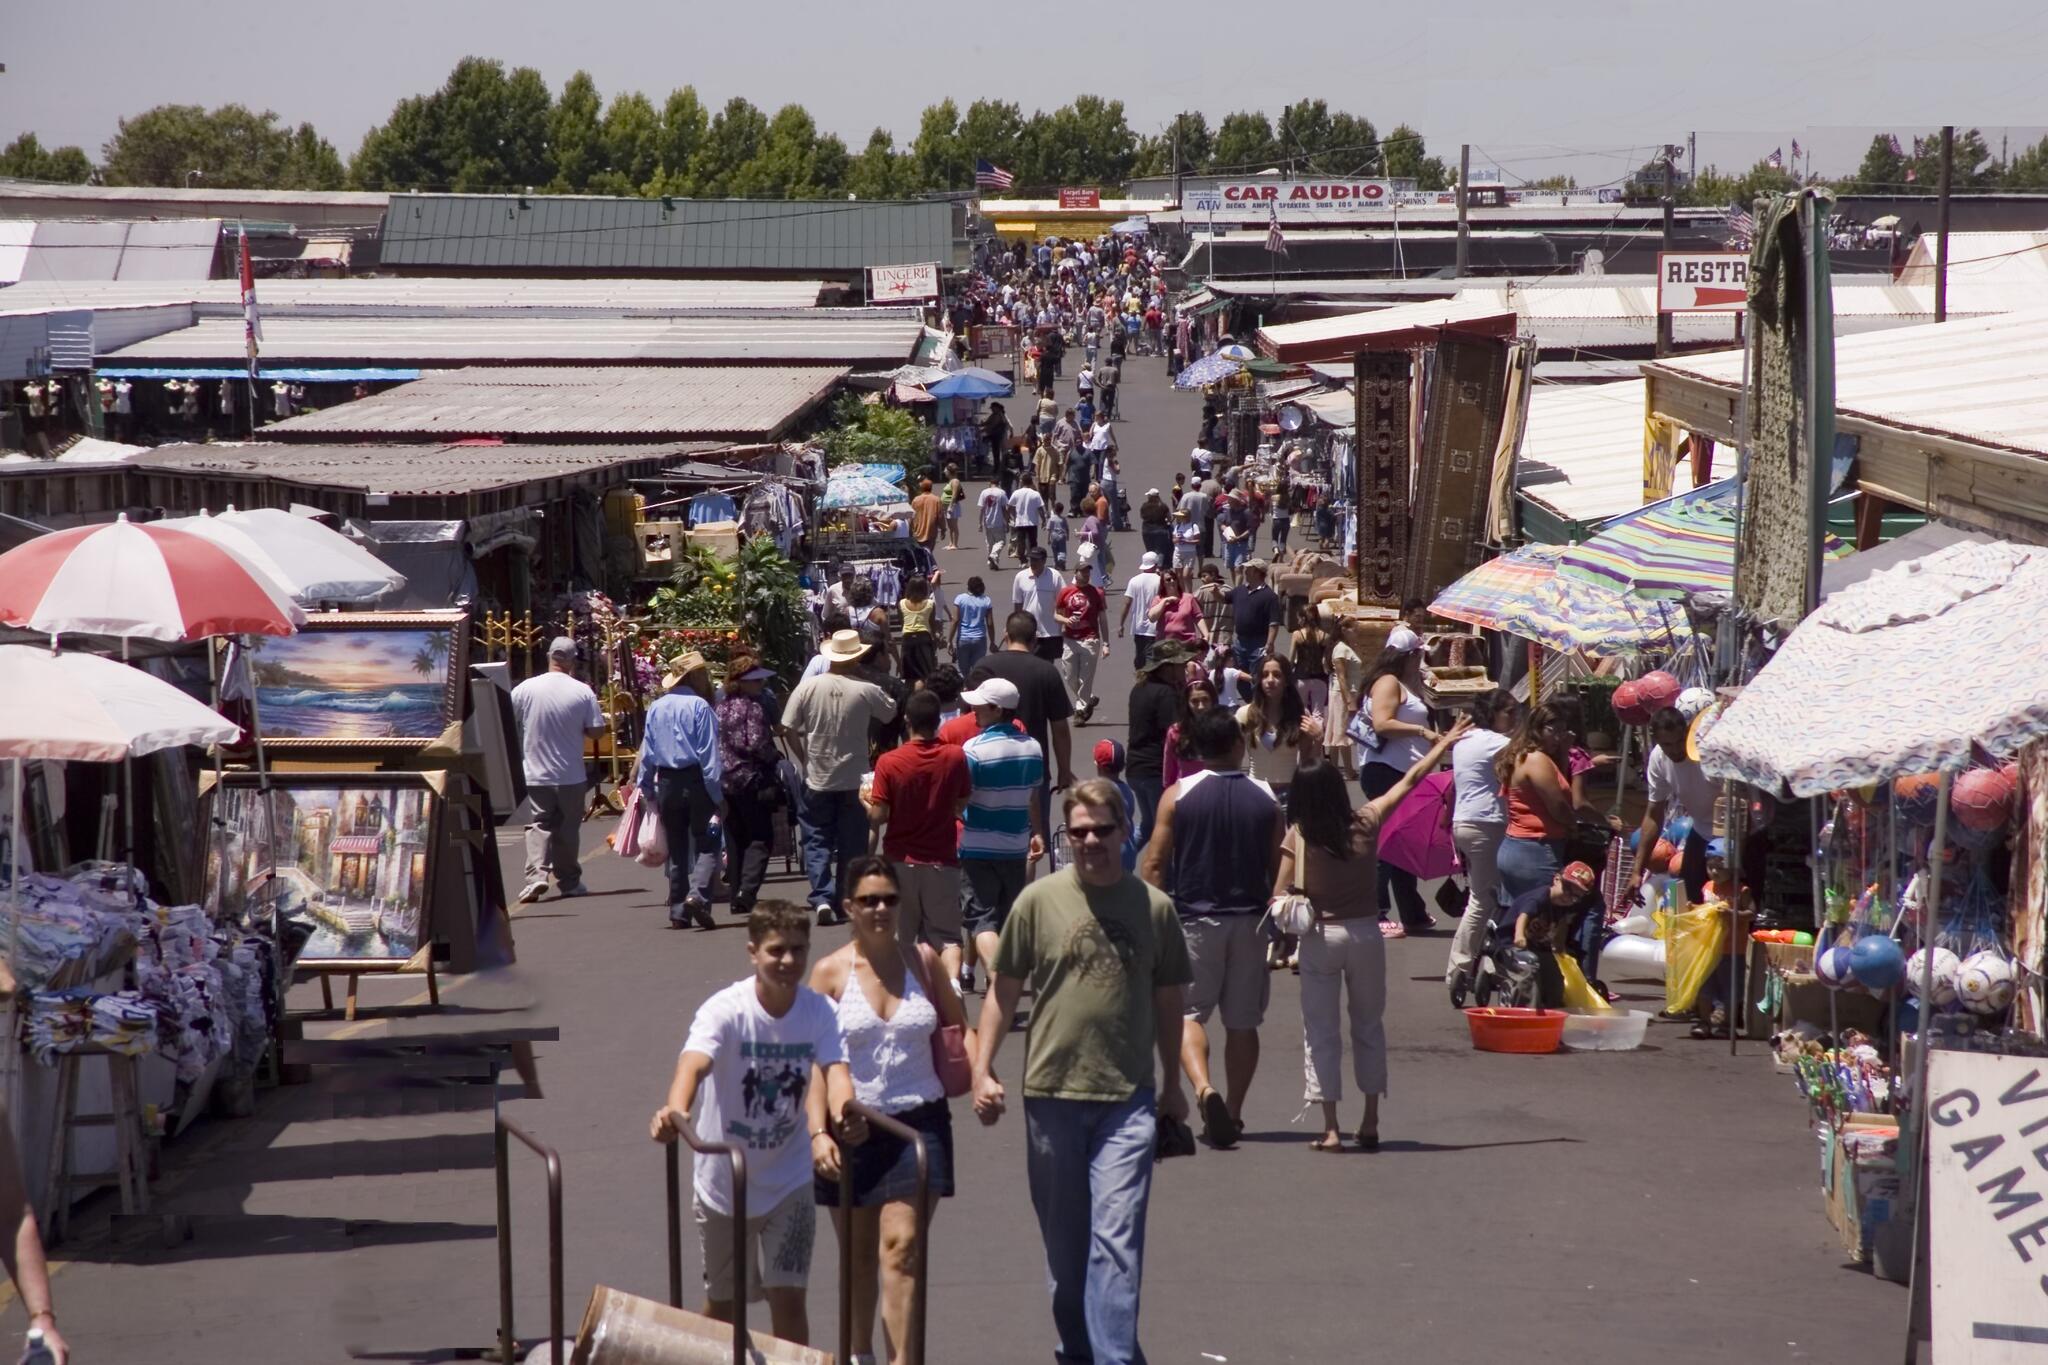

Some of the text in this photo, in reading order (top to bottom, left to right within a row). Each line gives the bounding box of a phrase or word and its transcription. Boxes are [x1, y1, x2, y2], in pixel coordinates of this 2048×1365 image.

[1224, 186, 1279, 201] CAR
[1289, 184, 1384, 201] AUDIO
[1358, 200, 1384, 208] ALARMS
[876, 266, 933, 282] LINGERIE
[1667, 261, 1747, 283] RESTR
[1930, 1087, 2048, 1298] GAME
